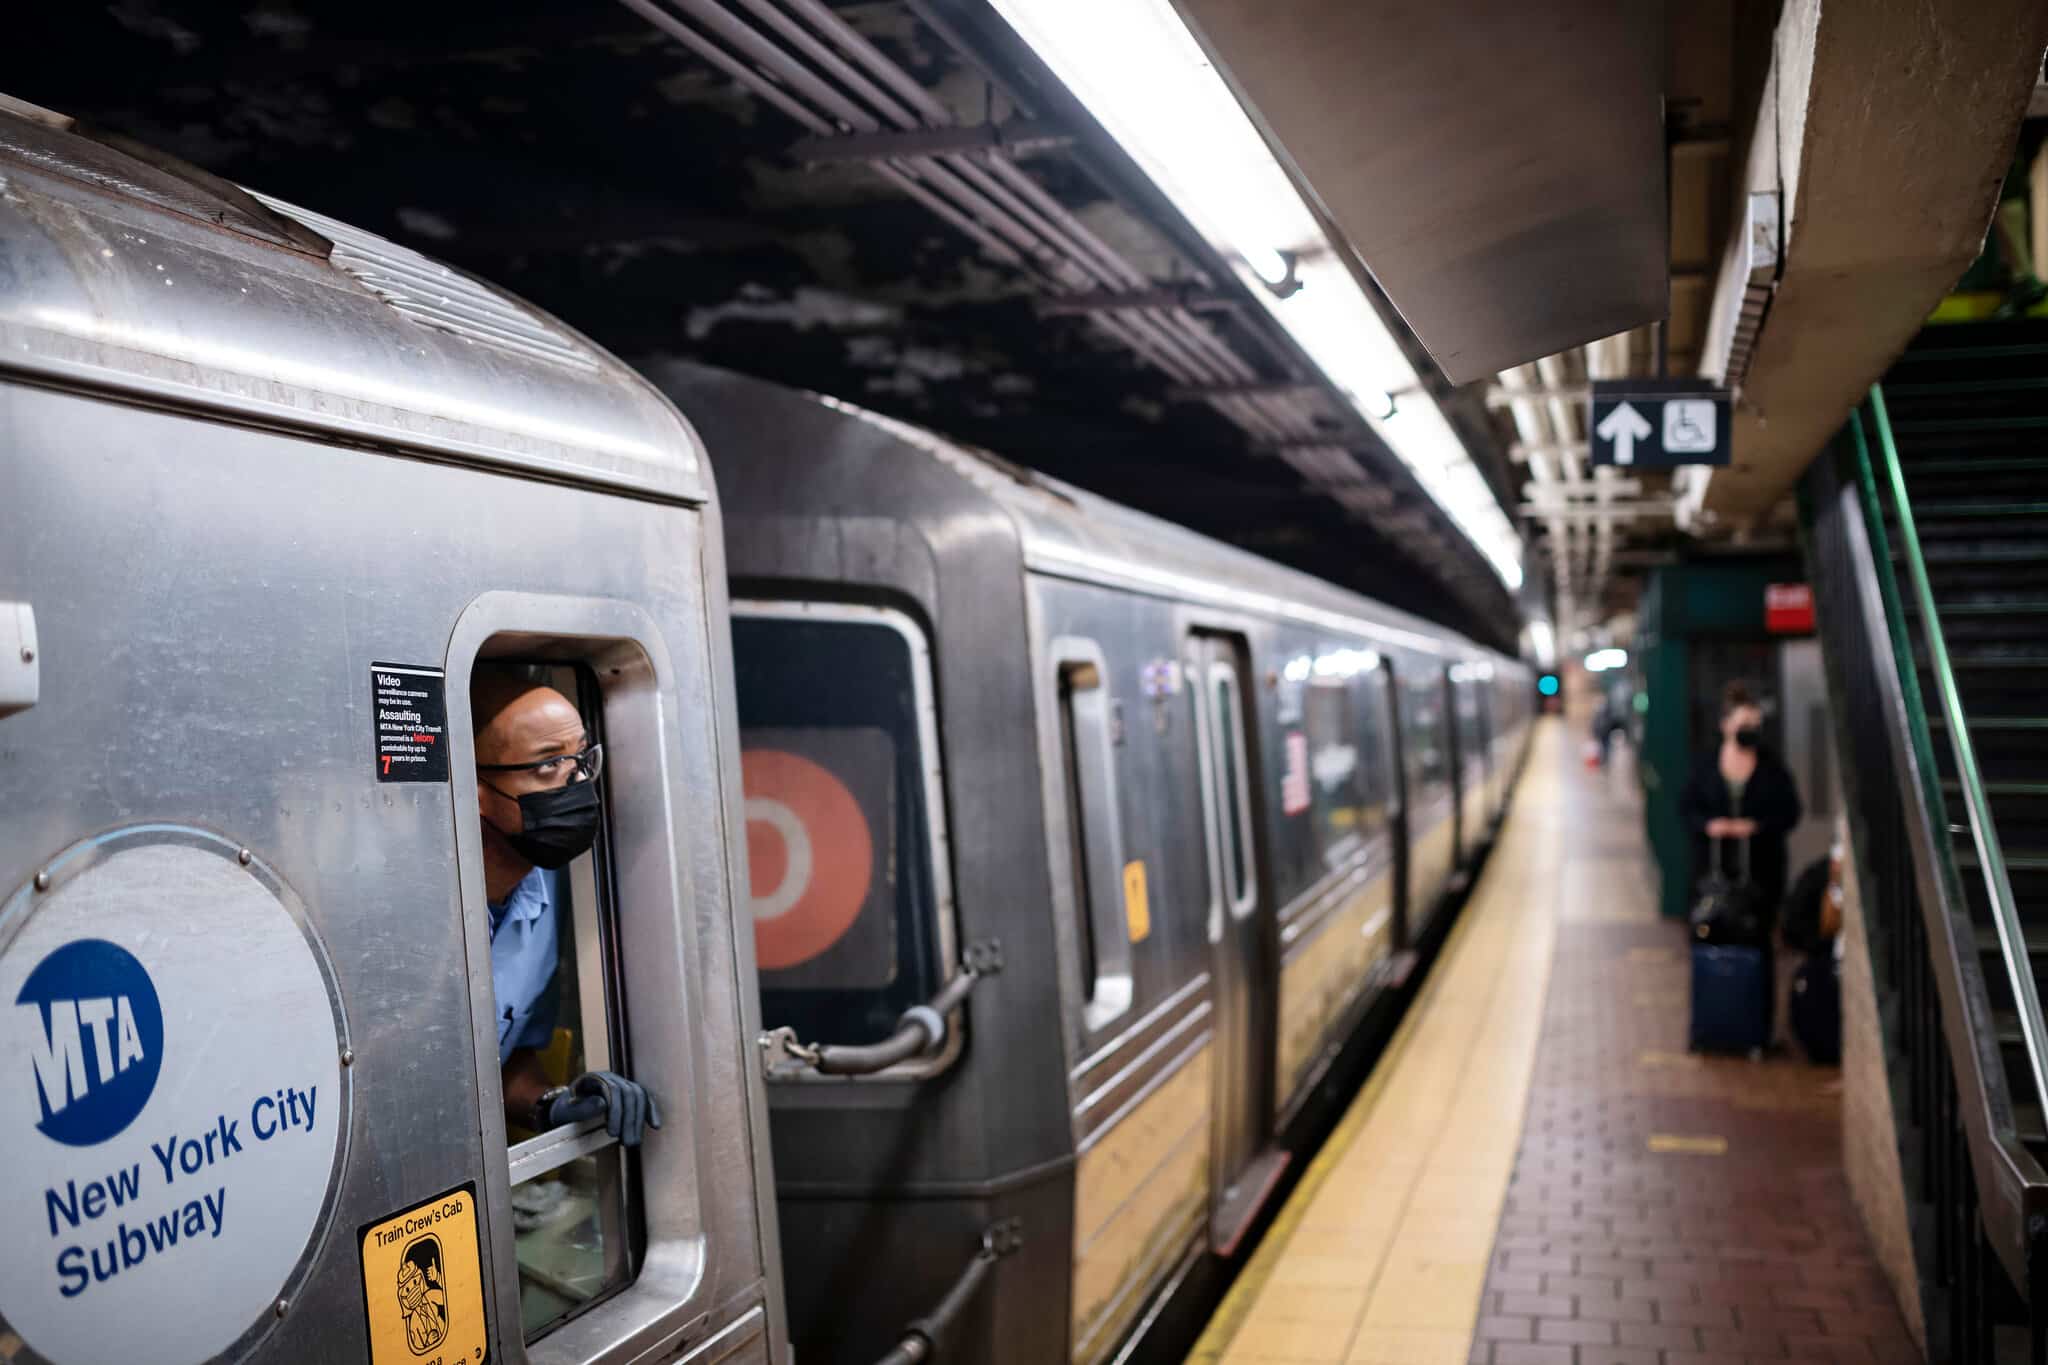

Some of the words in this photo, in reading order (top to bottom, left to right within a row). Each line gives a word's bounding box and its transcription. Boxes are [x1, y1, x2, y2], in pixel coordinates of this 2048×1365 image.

[377, 674, 401, 687] Video
[379, 708, 421, 724] Assaulting
[380, 755, 391, 775] 7
[15, 995, 145, 1127] MTA
[45, 1163, 140, 1238] New
[151, 1115, 243, 1185] York
[251, 1085, 317, 1141] City
[56, 1187, 226, 1298] Subway
[375, 1225, 404, 1248] Train
[405, 1209, 441, 1235] Crew's
[442, 1199, 463, 1219] Cab
